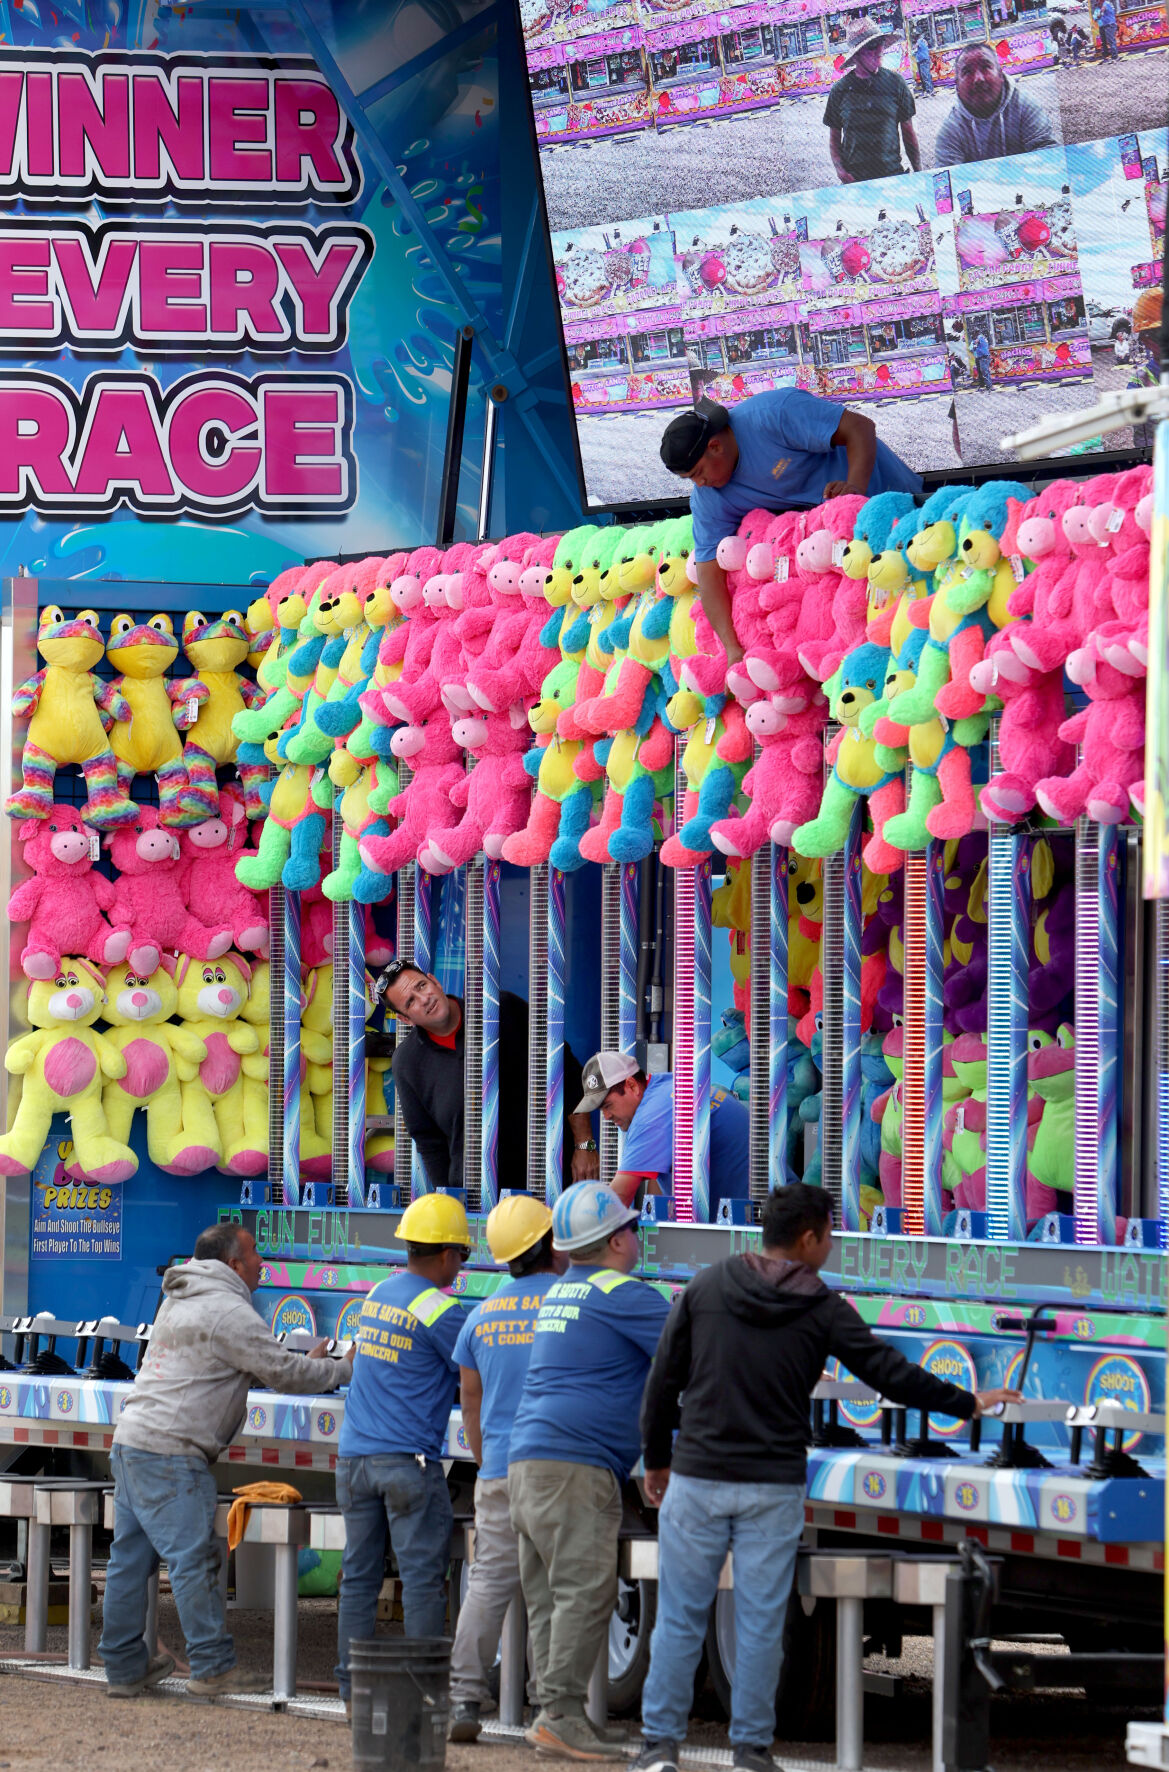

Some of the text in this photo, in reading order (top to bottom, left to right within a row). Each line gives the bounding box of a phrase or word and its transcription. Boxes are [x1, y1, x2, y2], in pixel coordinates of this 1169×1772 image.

[1125, 12, 1160, 26] NACHOS
[695, 80, 719, 93] CANDY
[0, 68, 346, 184] INNER
[0, 237, 358, 335] EVERY
[771, 366, 797, 378] CANDY
[888, 355, 945, 374] COTTON CANDY
[604, 377, 627, 387] CANDY
[0, 387, 344, 498] RACE
[43, 1187, 111, 1210] PRIZES
[34, 1219, 120, 1235] Aim And Shoot The Bullseye
[256, 1209, 349, 1256] GUN FUN
[33, 1239, 120, 1254] First Player To The Top Wins
[841, 1237, 1019, 1298] EVERY RACE
[480, 1296, 518, 1314] THINK
[378, 1304, 418, 1331] SAFETY!
[908, 1308, 919, 1323] 11
[476, 1320, 528, 1337] SAFETY
[380, 1330, 389, 1344] IS
[390, 1334, 413, 1351] OUR
[868, 1475, 880, 1495] 14
[962, 1487, 973, 1506] 15
[1057, 1499, 1069, 1519] 16
